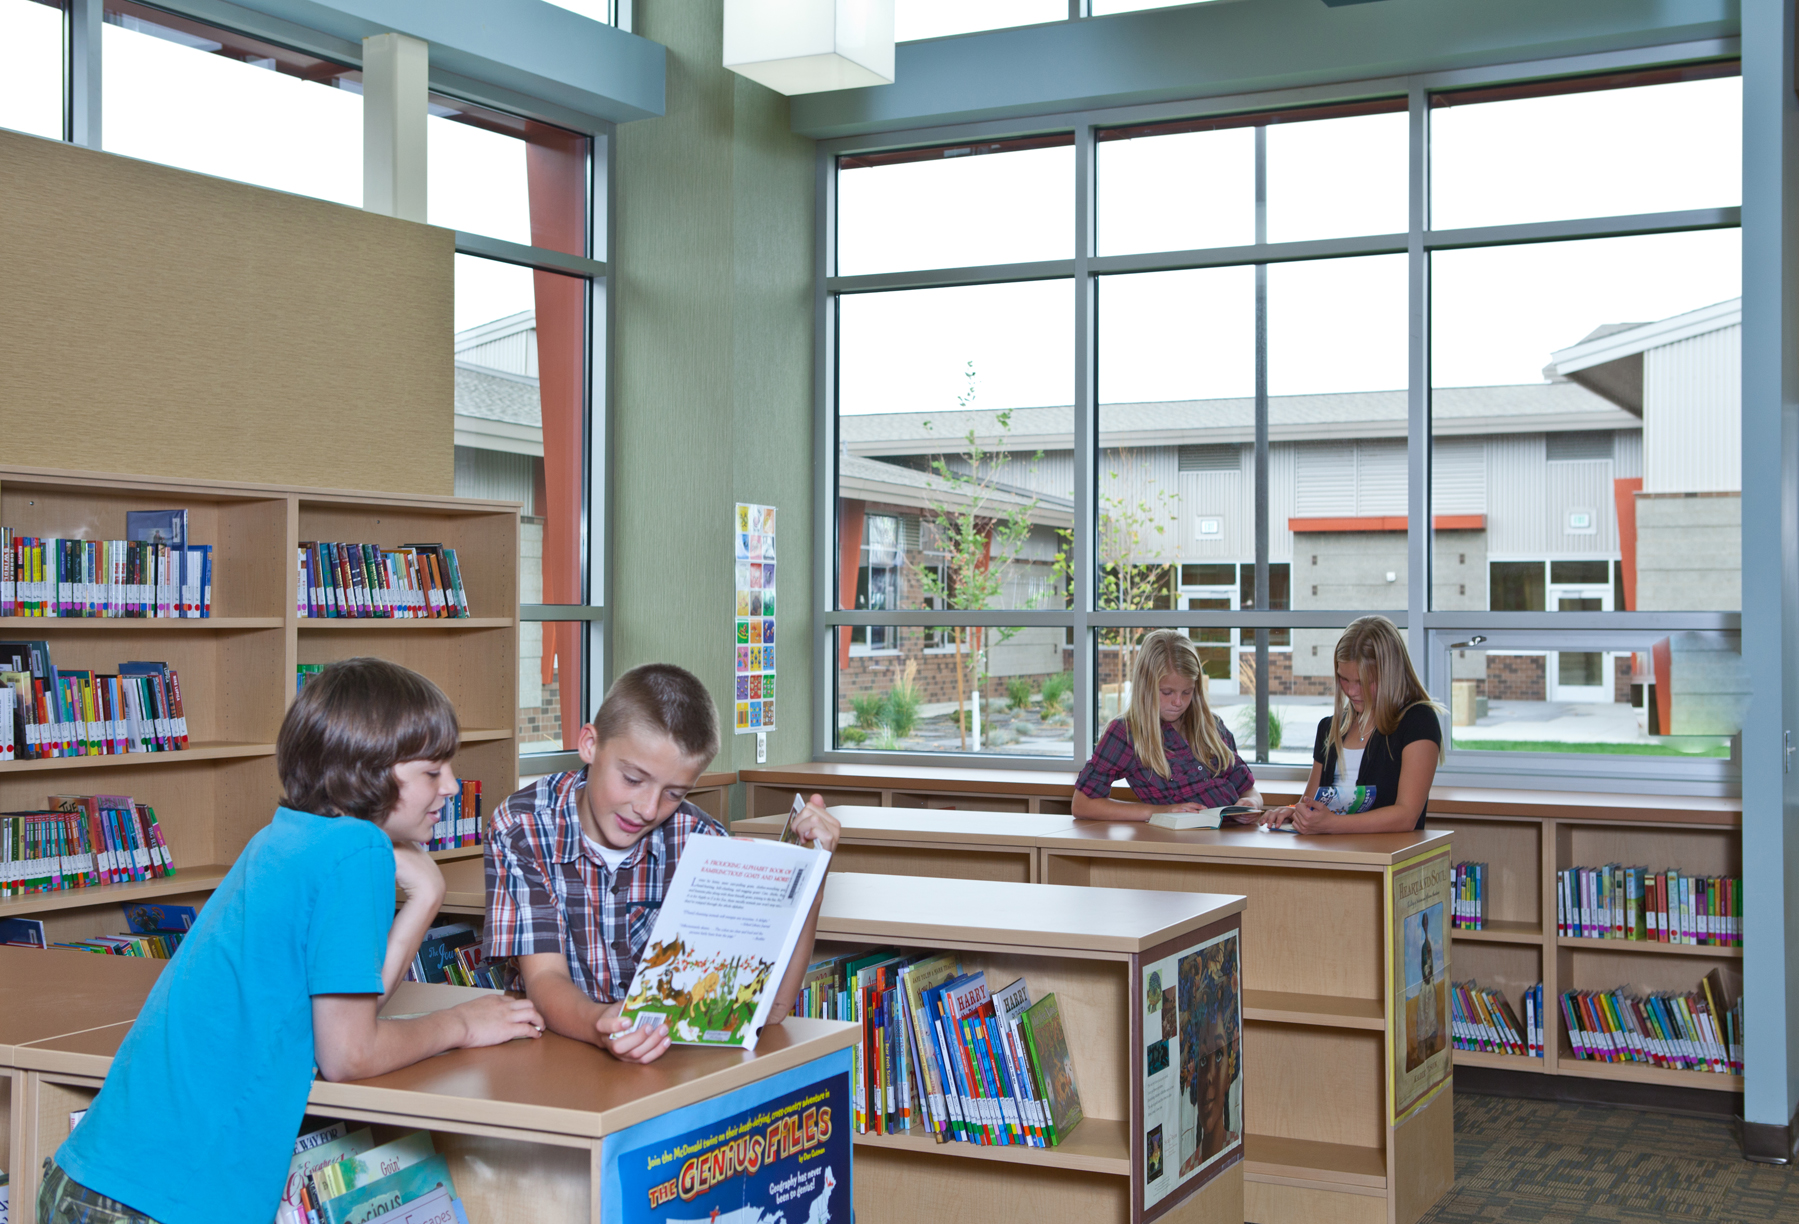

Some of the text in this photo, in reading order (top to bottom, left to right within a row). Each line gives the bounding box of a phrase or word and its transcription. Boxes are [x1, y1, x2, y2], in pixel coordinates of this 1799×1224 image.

[59, 801, 76, 812] THE
[957, 985, 986, 1011] HARRY
[1003, 987, 1028, 1013] HARRY
[300, 1134, 319, 1152] WAY
[320, 1128, 338, 1144] FOR
[647, 1155, 661, 1170] Join
[662, 1150, 673, 1164] the
[673, 1139, 702, 1160] McDonald
[703, 1135, 718, 1148] twins
[718, 1133, 725, 1142] on
[726, 1126, 738, 1140] their
[771, 1101, 802, 1120] cross-country
[802, 1094, 825, 1108] adventure
[825, 1088, 830, 1098] in
[380, 1156, 400, 1176] Goin'
[648, 1178, 677, 1209] THE
[769, 1167, 822, 1195] Geography has never
[776, 1177, 815, 1204] been so genius!
